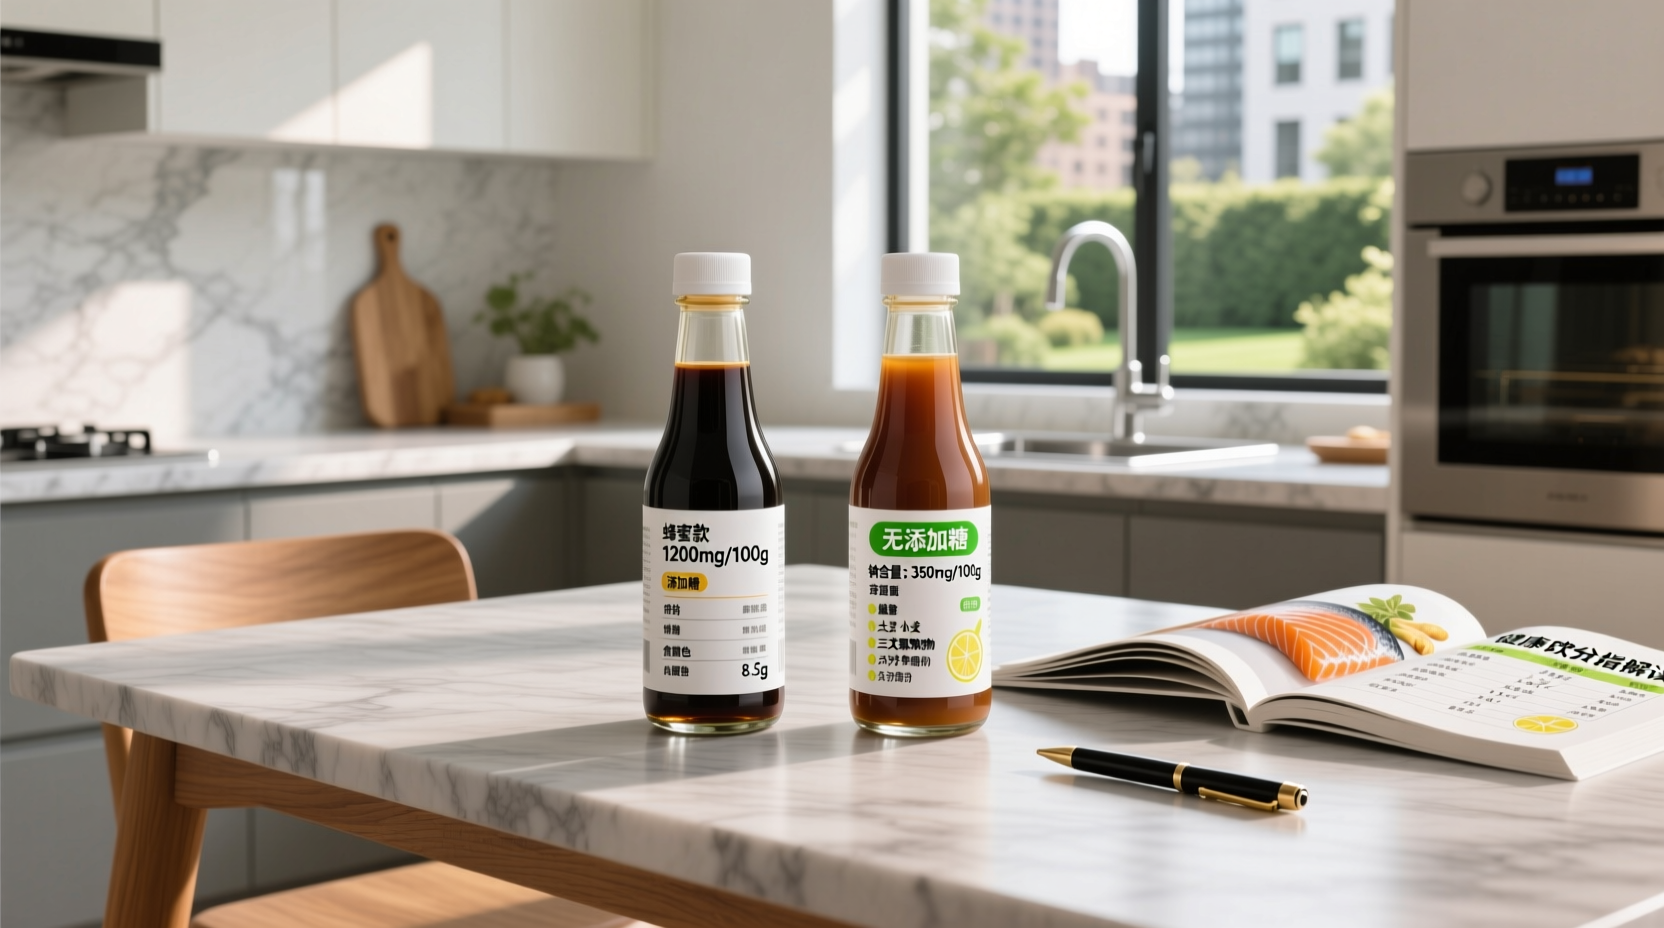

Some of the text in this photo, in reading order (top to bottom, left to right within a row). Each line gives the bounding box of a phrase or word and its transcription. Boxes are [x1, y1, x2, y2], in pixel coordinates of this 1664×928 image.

[882, 526, 969, 553] 无添加糖
[662, 545, 769, 568] 1200mg/100g
[741, 661, 768, 680] 8.5g
